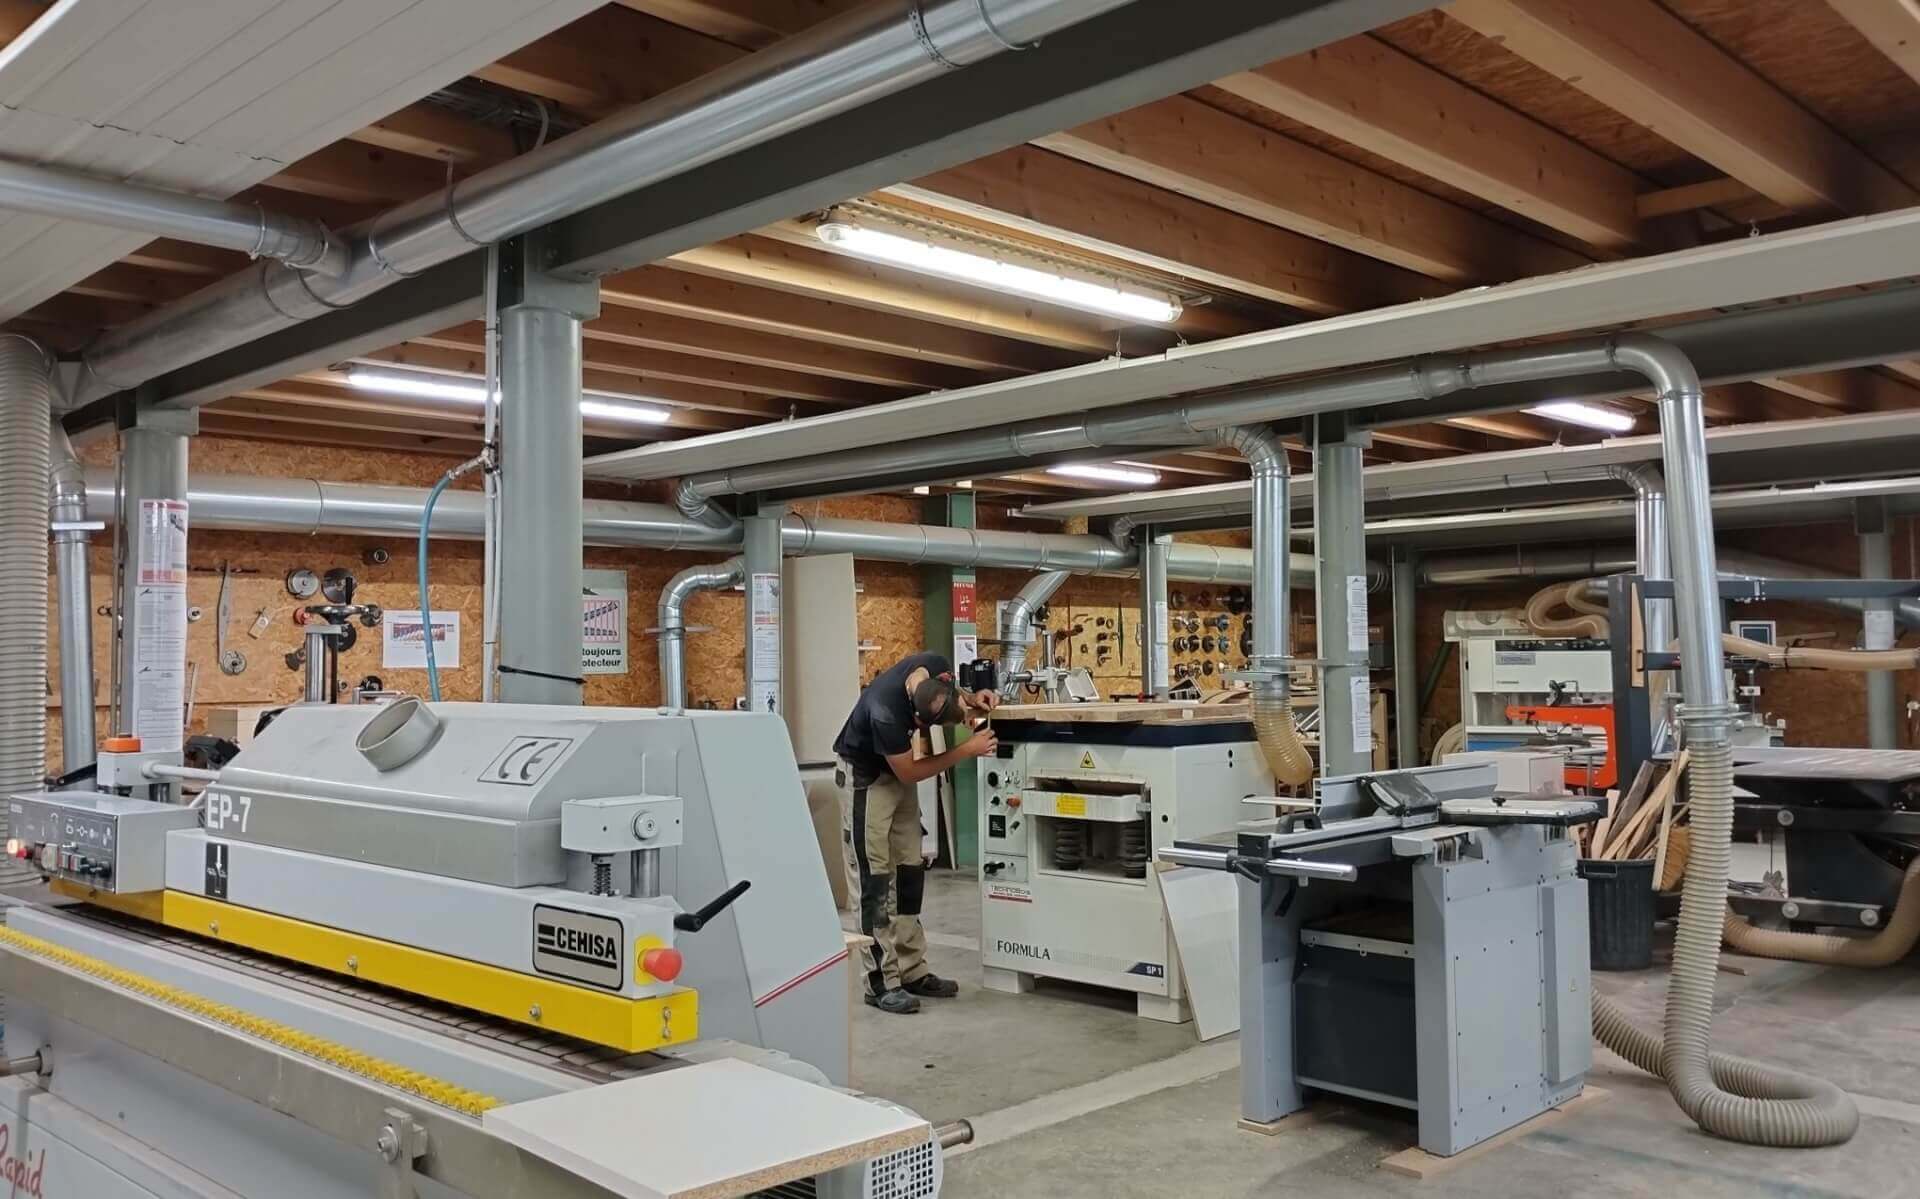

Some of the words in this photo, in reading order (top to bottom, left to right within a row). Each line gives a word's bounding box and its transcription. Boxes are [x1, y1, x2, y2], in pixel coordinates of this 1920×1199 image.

[207, 793, 251, 832] EP-7
[557, 926, 617, 960] CEHISA
[997, 940, 1050, 960] FORMULA
